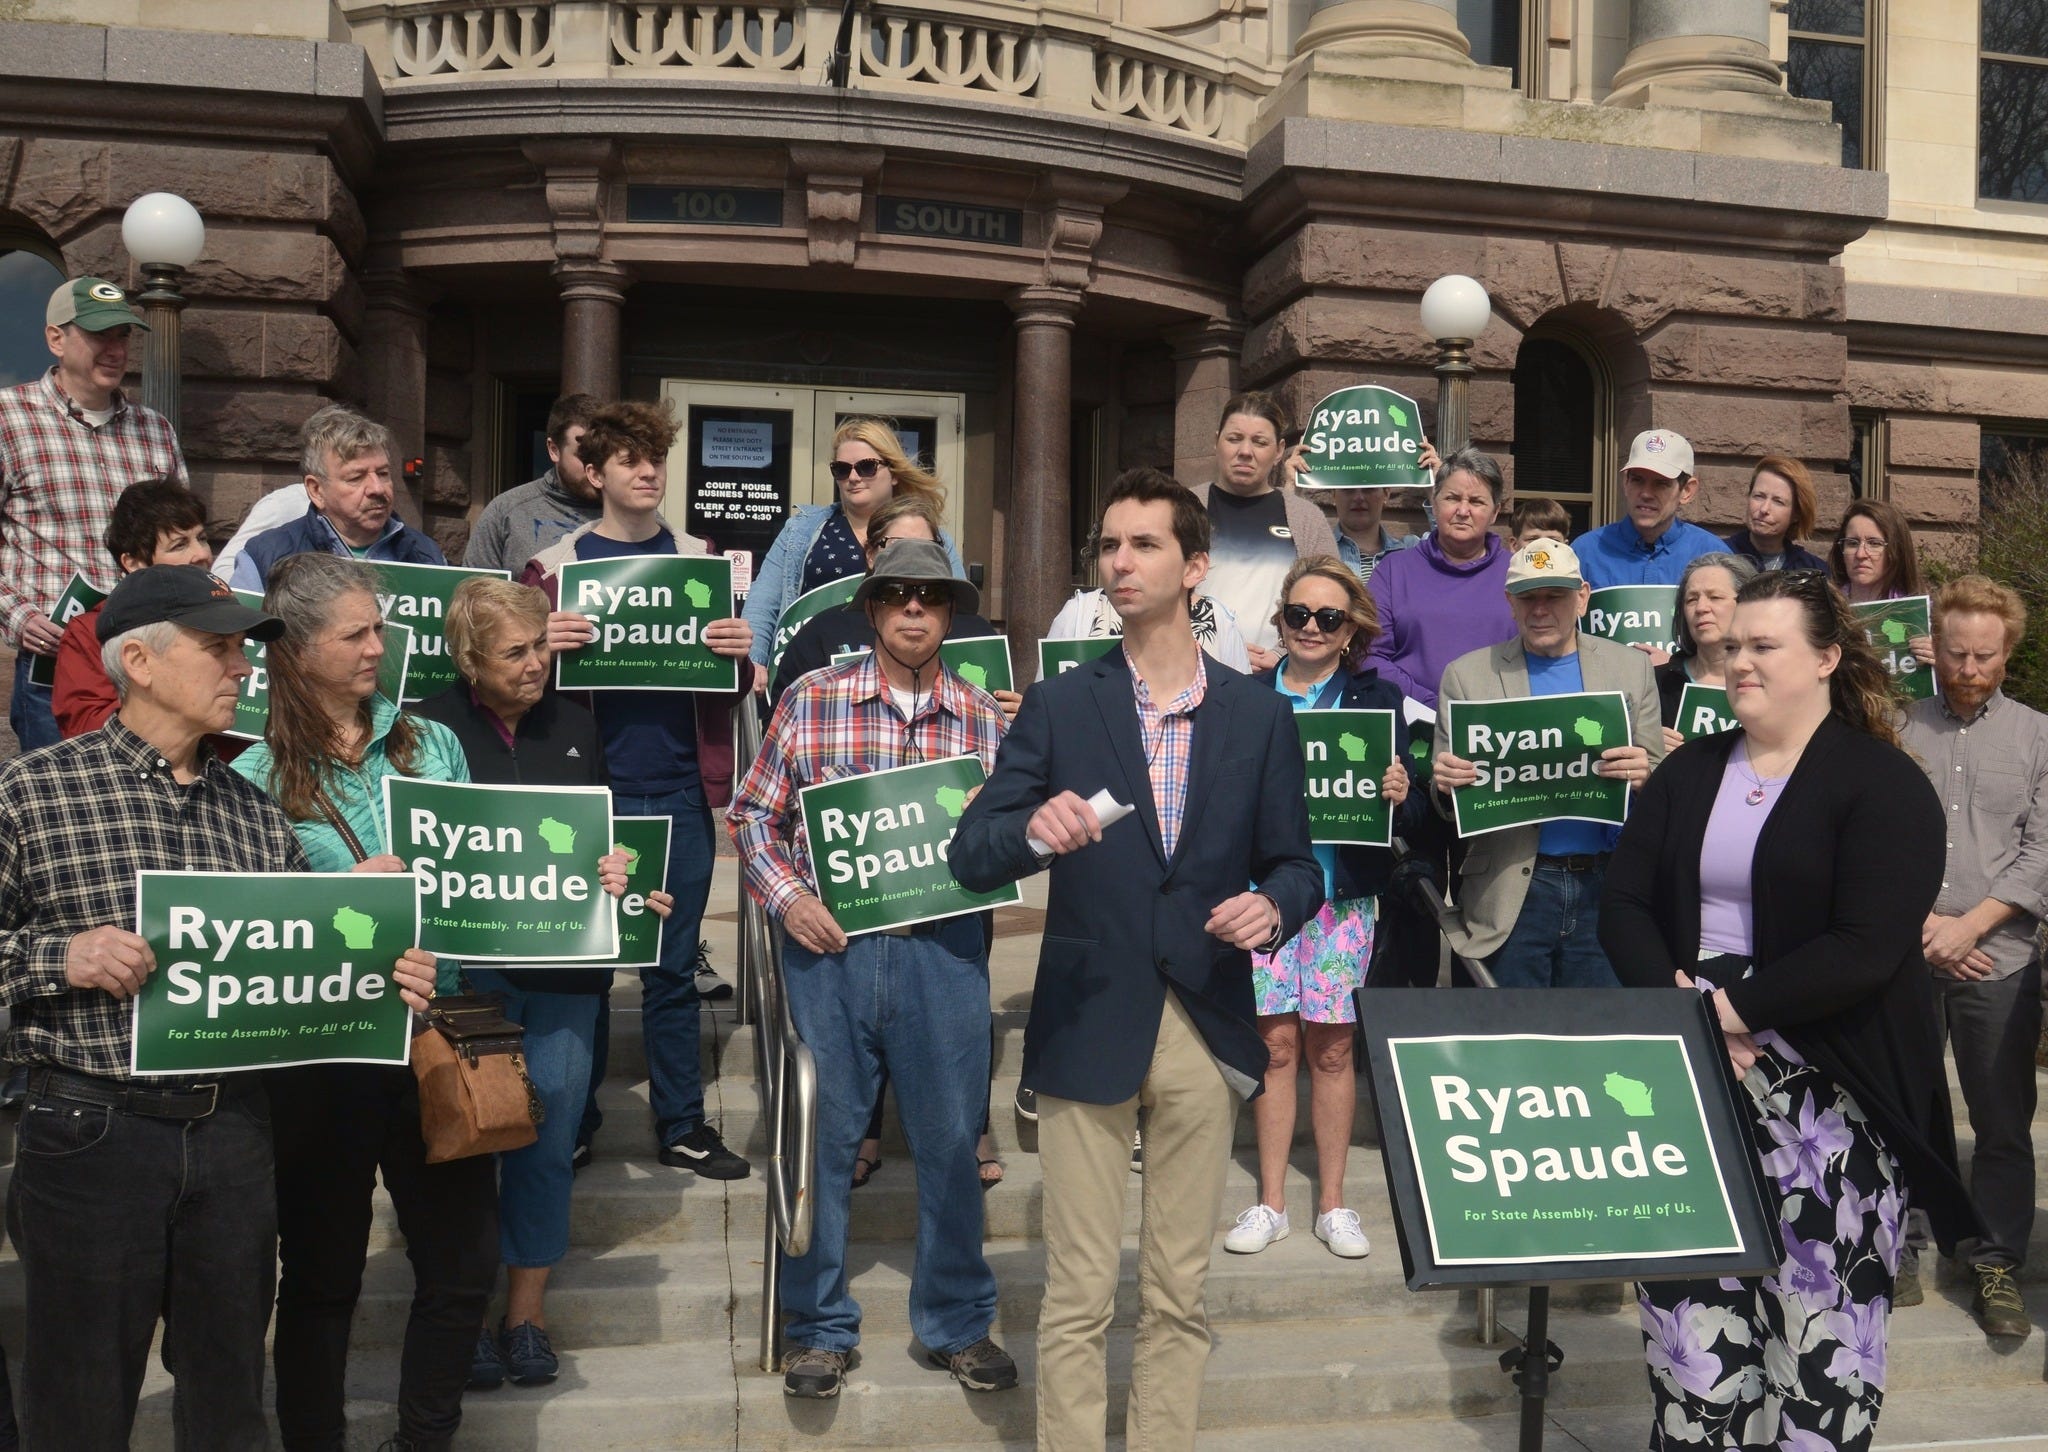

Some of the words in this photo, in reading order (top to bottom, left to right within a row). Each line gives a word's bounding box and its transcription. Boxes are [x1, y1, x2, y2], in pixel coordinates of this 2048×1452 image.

[672, 192, 736, 219] 100
[896, 204, 1005, 239] SOUTH
[1313, 408, 1380, 432] Ryan
[1310, 431, 1417, 460] Spaude
[1341, 463, 1372, 471] Assembly.
[1397, 463, 1405, 471] of
[1406, 463, 1416, 471] Us.
[698, 490, 743, 498] BUSINESS
[748, 491, 779, 500] HOURS
[705, 482, 737, 490] COURT
[742, 483, 772, 491] HOUSE
[694, 503, 725, 511] CLERK
[745, 505, 782, 513] COURTS
[376, 593, 442, 620] yan
[577, 579, 672, 615] Ryan
[1589, 608, 1661, 637] Ryan
[406, 671, 427, 680] mbly.
[431, 671, 444, 679] For
[445, 672, 456, 681] All
[579, 659, 592, 667] For
[619, 658, 658, 668] Assembly.
[663, 659, 676, 667] For
[678, 660, 690, 669] All
[692, 660, 702, 669] of
[704, 660, 717, 669] Us.
[235, 702, 260, 714] State
[1467, 724, 1563, 760] Ryan
[1306, 769, 1377, 799] ude
[1473, 802, 1486, 811] For
[1488, 798, 1509, 808] State
[1510, 794, 1550, 804] Assembly.
[1570, 791, 1582, 799] All
[1584, 791, 1594, 799] of
[1596, 791, 1608, 799] Us.
[820, 801, 926, 846] Ryan
[1338, 813, 1349, 823] All
[1351, 813, 1361, 822] of
[1362, 813, 1374, 822] Us.
[410, 808, 523, 860] Ryan
[412, 856, 588, 909] Spaude
[837, 901, 852, 910] For
[855, 896, 880, 908] State
[881, 887, 926, 902] Assembly.
[931, 882, 947, 892] For
[949, 880, 961, 890] Al
[169, 906, 314, 962] Ryan
[421, 917, 430, 925] or
[433, 917, 458, 927] State
[461, 919, 509, 931] Assembly.
[517, 920, 533, 930] For
[537, 920, 551, 932] All
[555, 920, 567, 931] of
[569, 921, 587, 931] Us.
[625, 933, 639, 941] Us.
[167, 961, 386, 1019] Spaude
[168, 1029, 189, 1040] For
[194, 1028, 228, 1039] State
[231, 1025, 291, 1039] Assembly.
[299, 1024, 319, 1035] For
[321, 1023, 338, 1035] All
[341, 1021, 355, 1033] of
[358, 1021, 377, 1031] Us.
[1430, 1075, 1591, 1134] Ryan
[1444, 1130, 1689, 1197] Spaude
[1464, 1209, 1487, 1221] For
[1492, 1208, 1528, 1221] State
[1532, 1206, 1598, 1222] Assembly.
[1607, 1205, 1629, 1217] For
[1633, 1203, 1652, 1218] All
[1656, 1202, 1670, 1217] of
[1674, 1202, 1696, 1215] Us.
